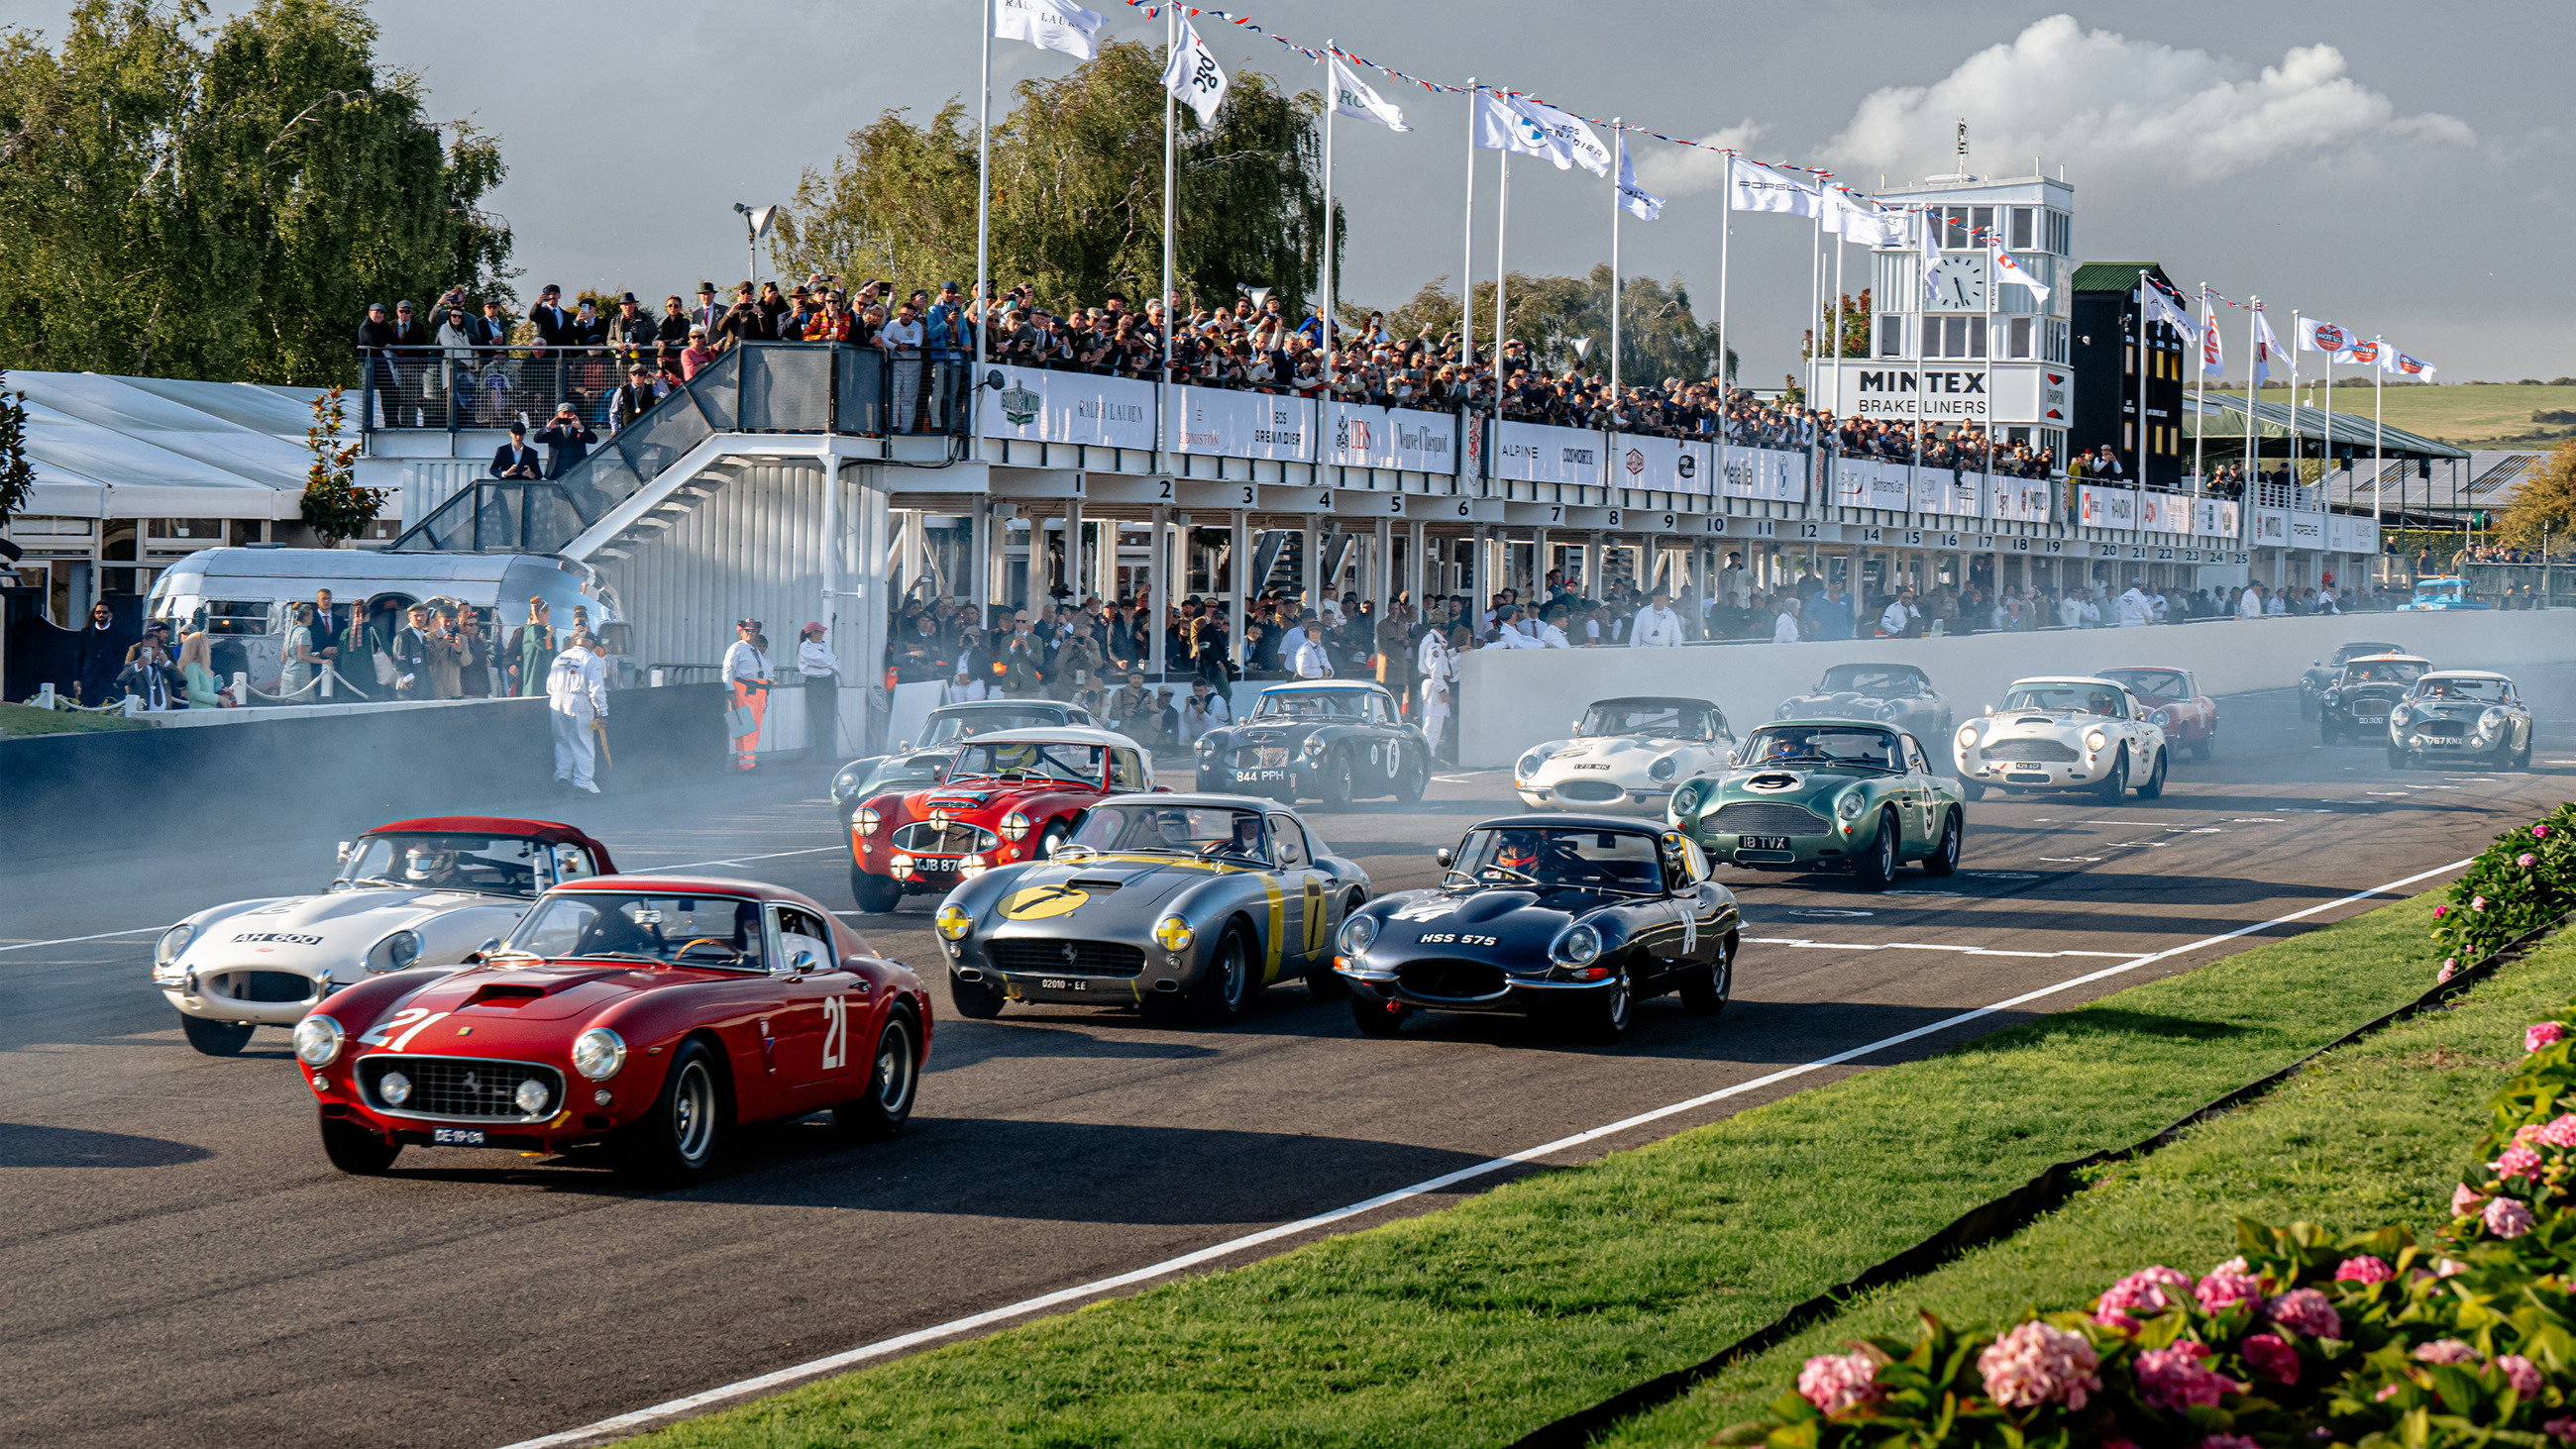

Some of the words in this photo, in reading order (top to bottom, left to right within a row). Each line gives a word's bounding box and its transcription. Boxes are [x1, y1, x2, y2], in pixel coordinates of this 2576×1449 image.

[1738, 180, 1818, 197] PORSCH
[1860, 370, 1986, 393] MINTEX
[1079, 401, 1106, 419] RALPH
[1110, 403, 1143, 422] LAUREN
[1859, 399, 1915, 413] BRAKE
[1924, 400, 1986, 414] LINERS
[1178, 432, 1220, 447] EDMISTON
[1255, 429, 1301, 446] GRENADIER
[1350, 420, 1371, 450] UBS
[1502, 445, 1538, 459] ALPINE
[1076, 474, 1081, 492] 1
[1159, 480, 1171, 498] 2
[1242, 486, 1253, 503] 3
[1319, 491, 1331, 508] 4
[1391, 496, 1402, 512] 5
[1458, 500, 1468, 516] 6
[1552, 507, 1561, 522] 7
[1609, 511, 1619, 525] 8
[1664, 514, 1674, 528] 9
[1707, 518, 1724, 532] 10
[1758, 521, 1771, 535] 11
[1801, 525, 1817, 538] 12
[1865, 529, 1879, 542] 14
[1905, 532, 1920, 544] 15
[1943, 534, 1957, 546] 16
[1979, 536, 1992, 548] 17
[2013, 539, 2027, 550] 18
[2047, 541, 2060, 553] 19
[2102, 545, 2116, 556] 20
[2132, 547, 2146, 558] 21
[2158, 549, 2173, 559] 22
[2186, 551, 2199, 561] 23
[2209, 552, 2223, 563] 24
[2234, 554, 2248, 565] 25
[1236, 771, 1257, 782] 844
[1261, 770, 1284, 781] PPH
[1923, 786, 1934, 831] 9
[1743, 836, 1757, 849] 18
[1760, 836, 1785, 849] TVX
[913, 858, 939, 872] XJB
[1010, 885, 1082, 913] 7
[1306, 883, 1321, 952] 7
[233, 933, 268, 943] AH
[270, 933, 320, 945] 600
[1420, 933, 1455, 944] HSS
[1460, 934, 1497, 947] 575
[1041, 979, 1066, 989] 02010
[1074, 981, 1087, 990] EE
[357, 1007, 452, 1052] 21
[821, 994, 847, 1070] 21
